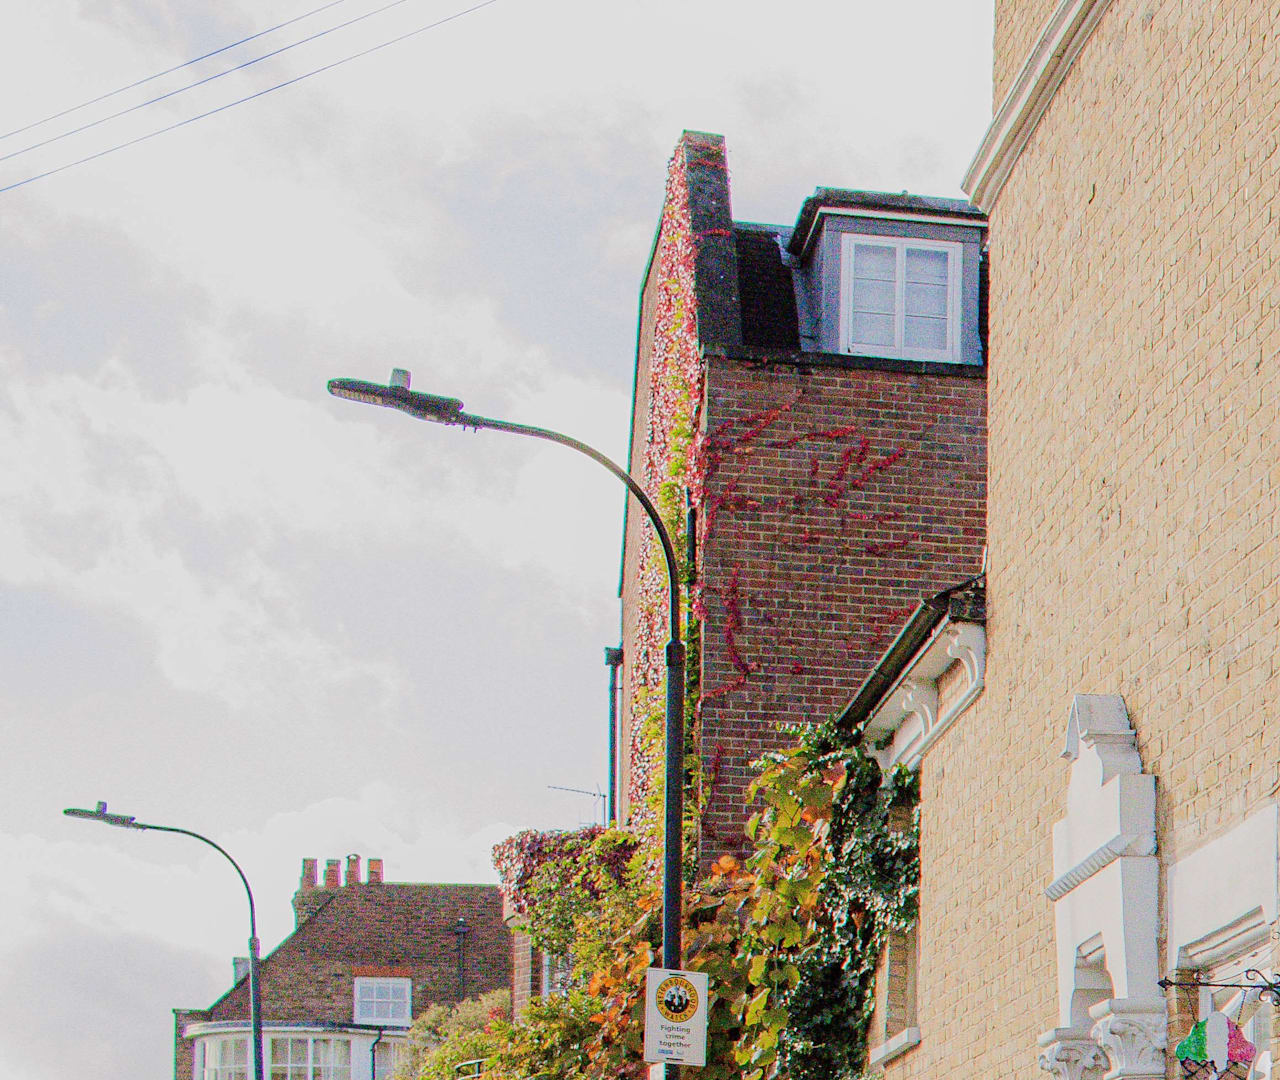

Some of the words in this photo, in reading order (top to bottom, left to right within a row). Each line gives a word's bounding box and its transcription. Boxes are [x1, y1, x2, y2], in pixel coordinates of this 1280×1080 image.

[658, 978, 696, 1009] NEIGHBOURHOOD
[664, 1010, 688, 1020] WATCH
[660, 1024, 690, 1034] Fighting
